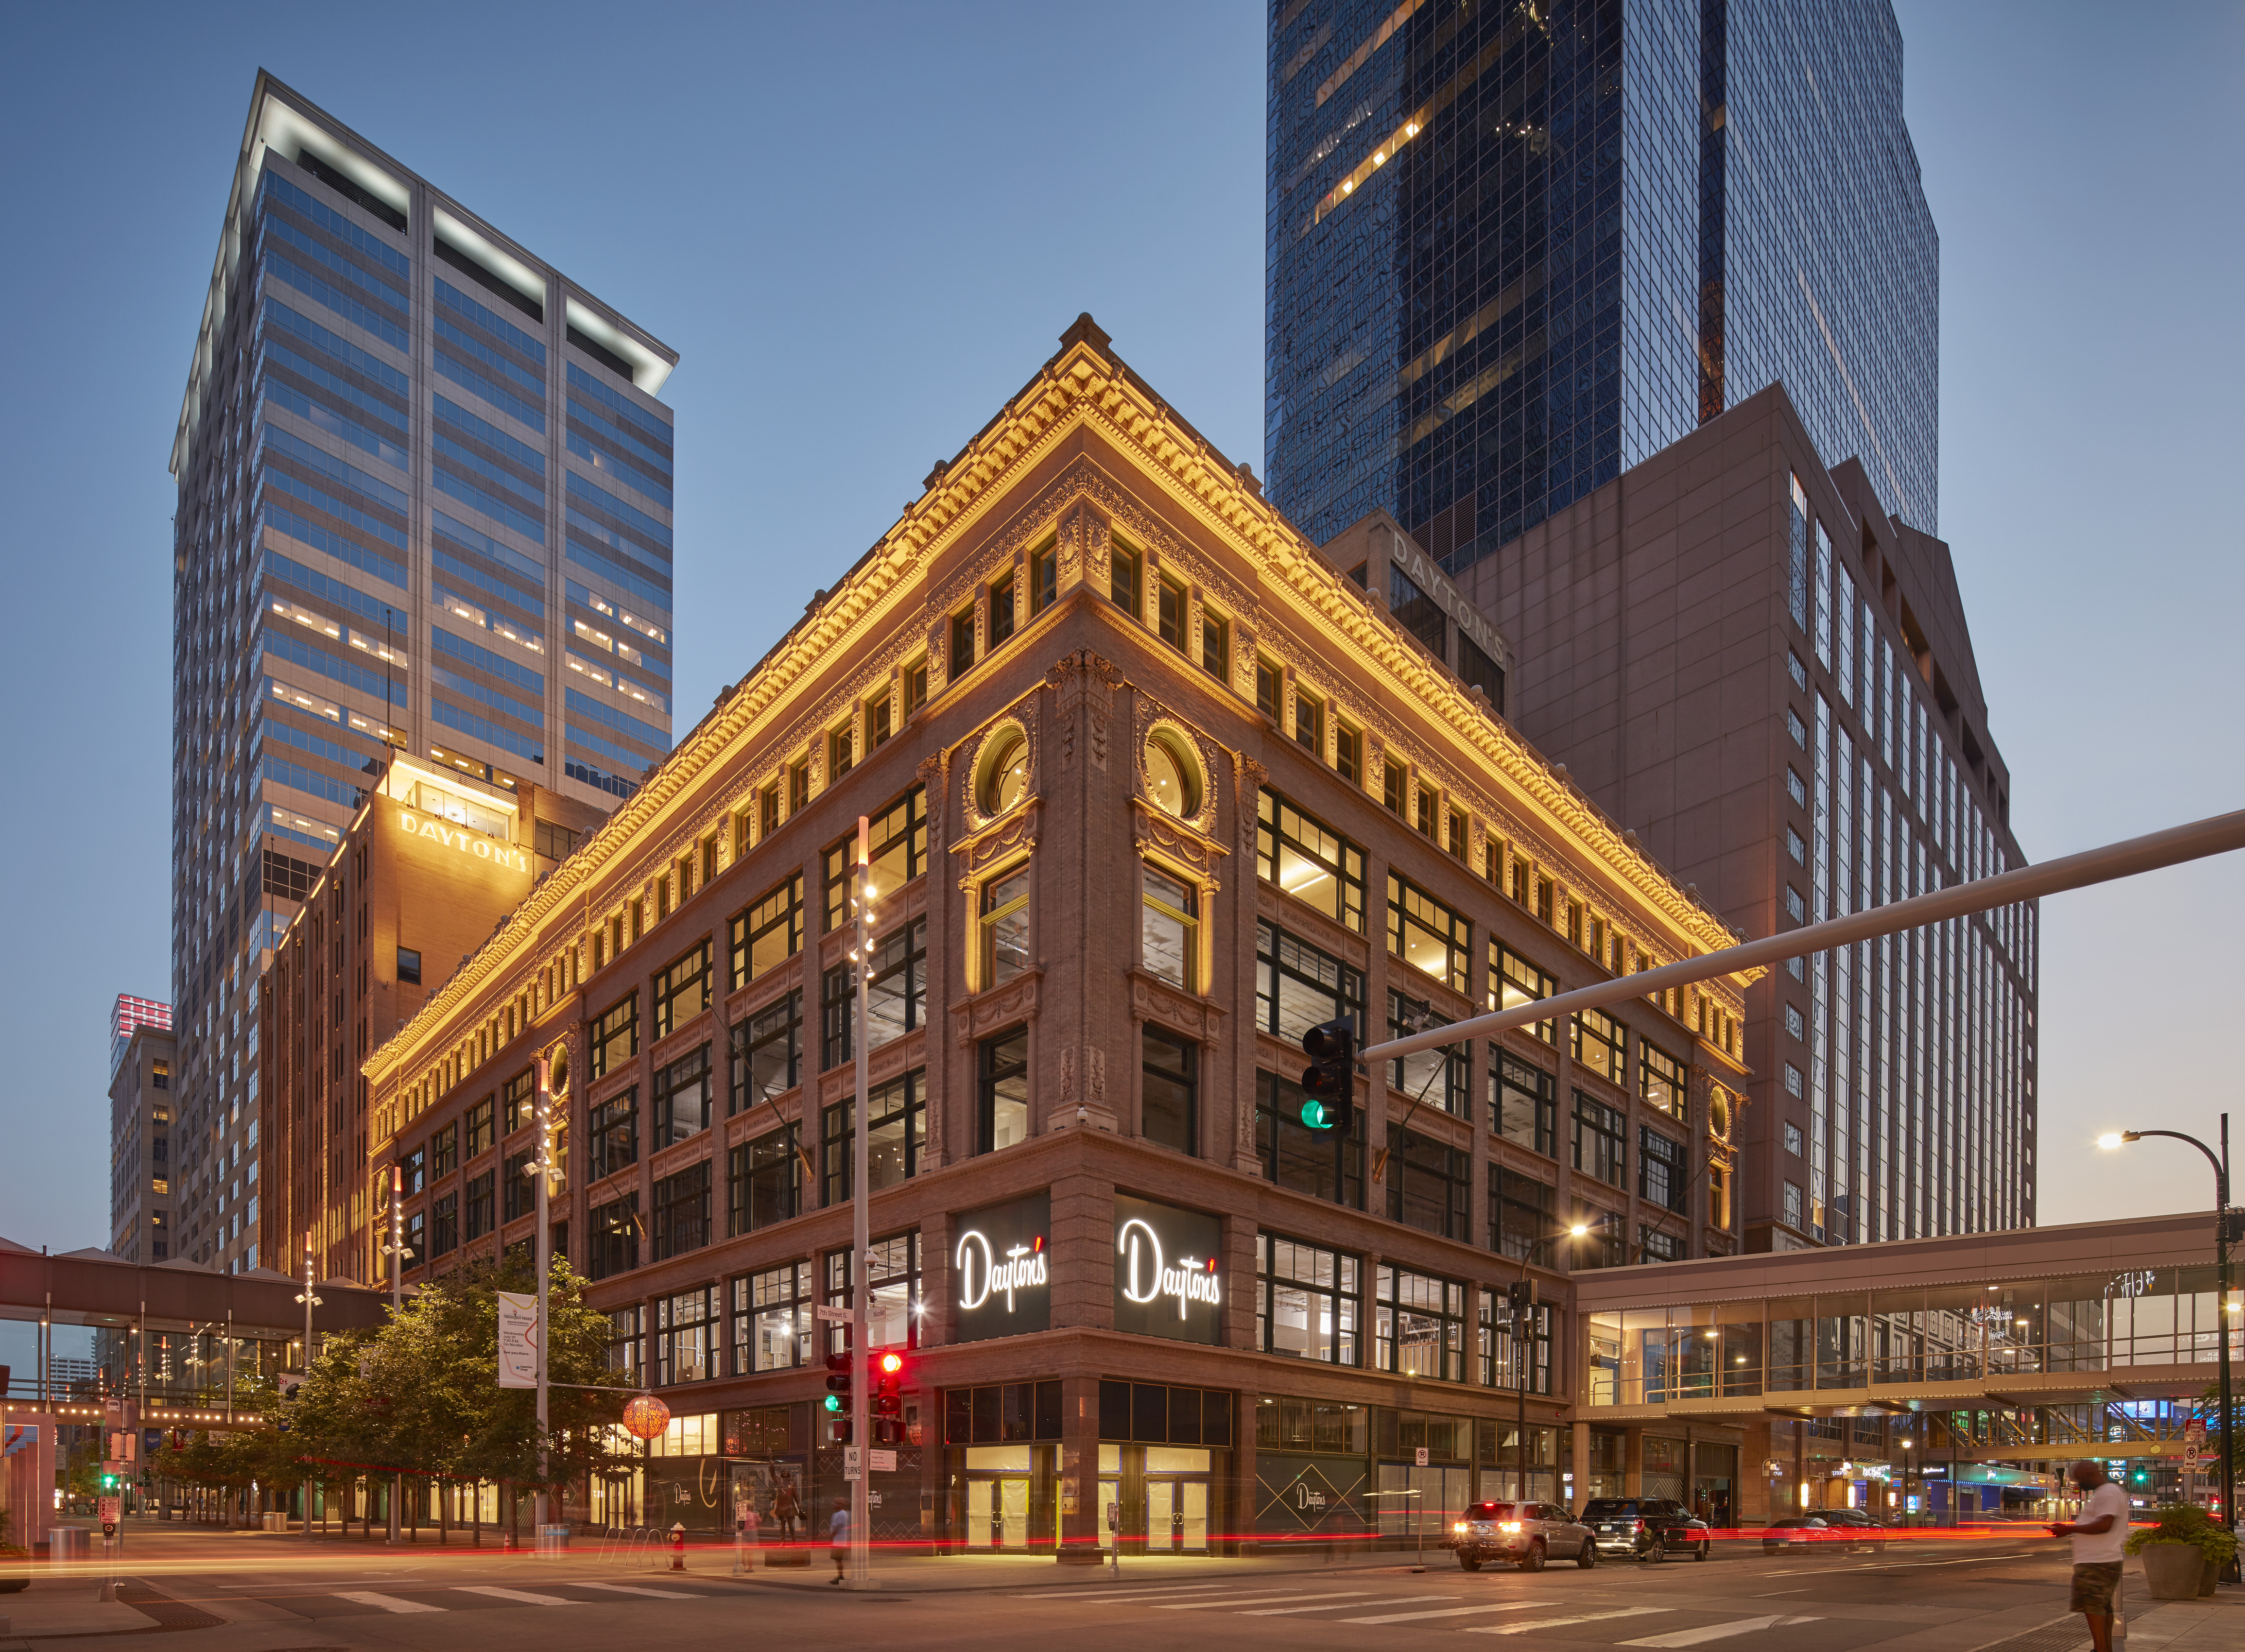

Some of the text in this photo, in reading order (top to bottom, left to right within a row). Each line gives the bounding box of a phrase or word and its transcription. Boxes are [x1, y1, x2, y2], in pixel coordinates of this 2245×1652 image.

[1394, 531, 1503, 663] DAYTON'S
[401, 813, 526, 873] DAYTON'S
[956, 1230, 1048, 1313] Dayton's
[1120, 1219, 1220, 1321] Dayton's
[845, 1466, 861, 1475] TURNS
[849, 1451, 857, 1462] NO
[674, 1483, 691, 1507] Dayton's
[1296, 1482, 1326, 1512] Dayton's
